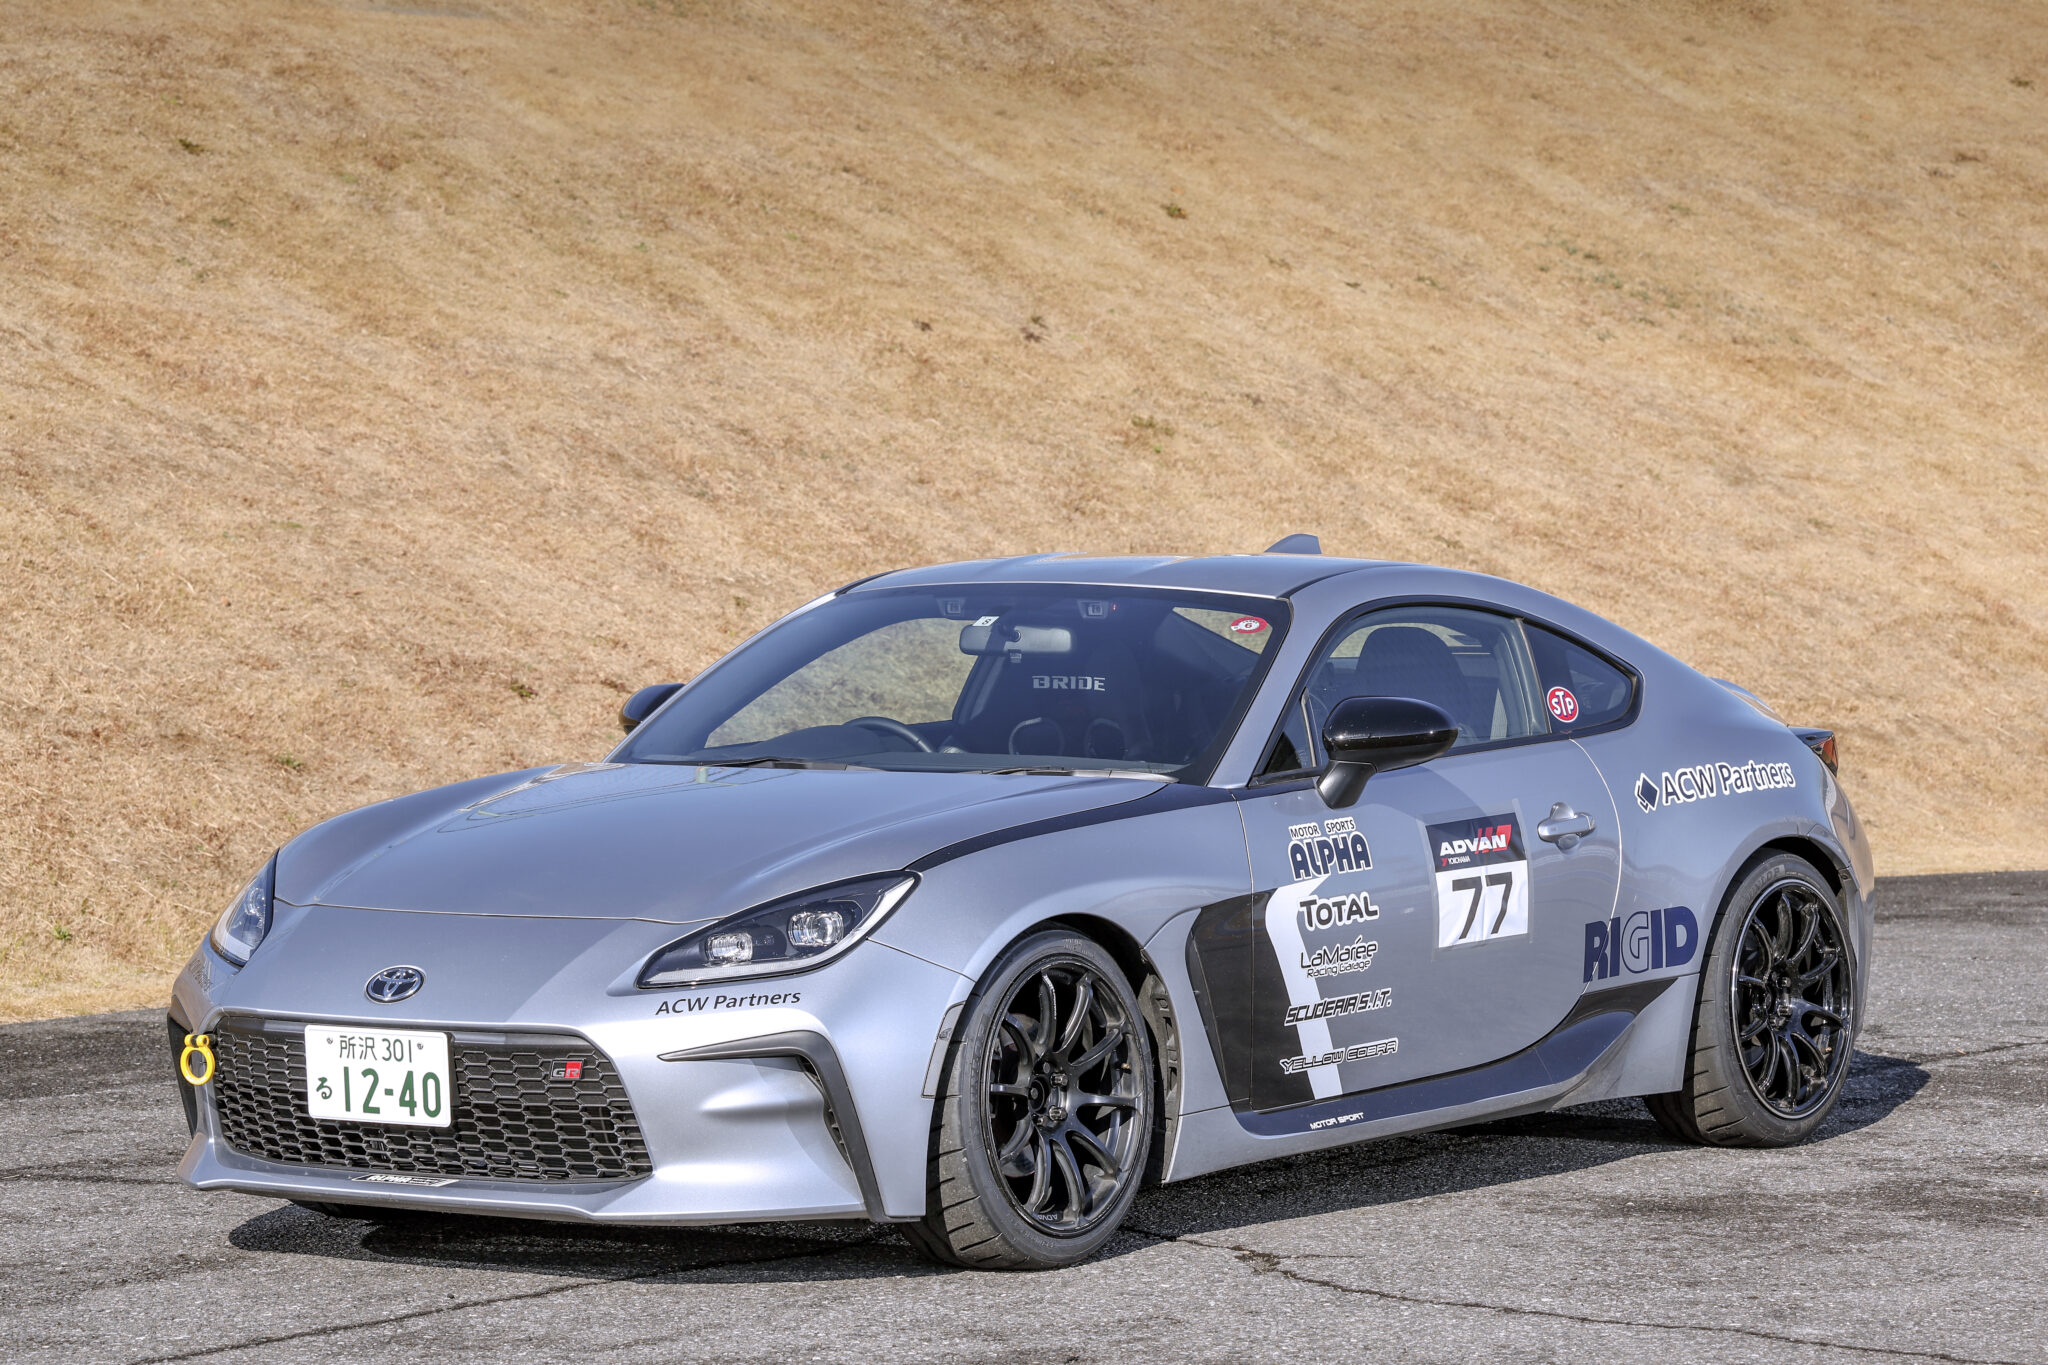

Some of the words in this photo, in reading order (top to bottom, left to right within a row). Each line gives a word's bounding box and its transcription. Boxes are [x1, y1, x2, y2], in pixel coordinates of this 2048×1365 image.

[1032, 675, 1106, 691] BRIDE
[1551, 690, 1575, 717] STP
[1663, 765, 1716, 805] ACW
[1717, 761, 1795, 793] Partners
[1289, 824, 1320, 839] MOTOR
[1325, 818, 1355, 834] SPORTS
[1289, 832, 1372, 880] ALPHA
[1440, 834, 1507, 857] ADVAN
[1299, 895, 1379, 929] TOTAL
[1452, 871, 1513, 940] 77
[1300, 936, 1377, 969] LaMarée
[1583, 906, 1699, 984] RIGID
[1307, 963, 1338, 978] Racing
[1339, 959, 1371, 973] Garage
[655, 996, 709, 1016] ACW
[713, 992, 801, 1010] Partners
[1285, 996, 1358, 1025] SCUDERIA
[1358, 989, 1392, 1012] S.I.T.
[339, 1035, 378, 1061] 所沢
[382, 1037, 412, 1063] 301
[1280, 1050, 1345, 1074] YELLOW
[1347, 1040, 1398, 1061] COBRA
[553, 1068, 580, 1078] GR
[316, 1076, 333, 1100] る
[343, 1066, 442, 1118] 12-40
[1309, 1117, 1337, 1130] MOTOR
[1337, 1111, 1364, 1124] SPORT
